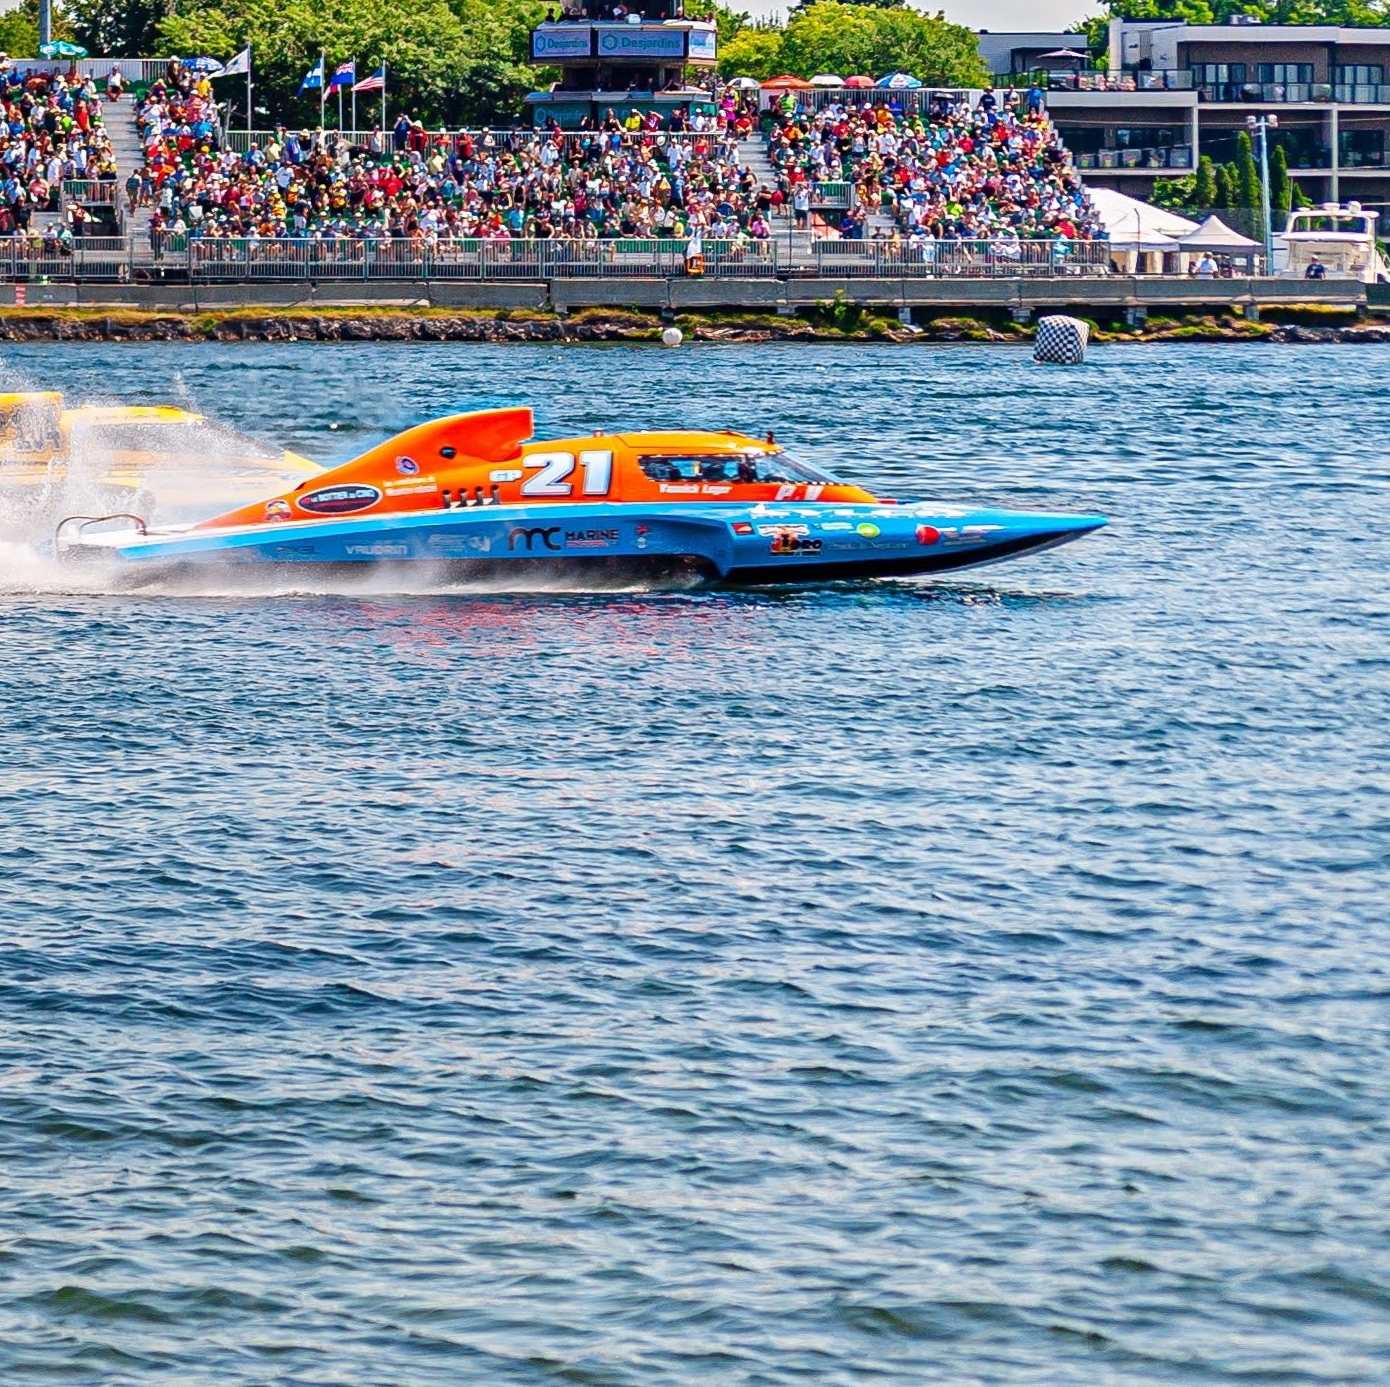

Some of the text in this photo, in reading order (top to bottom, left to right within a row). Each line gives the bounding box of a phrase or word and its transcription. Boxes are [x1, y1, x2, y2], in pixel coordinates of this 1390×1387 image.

[547, 37, 588, 50] Desjardins
[621, 36, 680, 49] Desjardins
[520, 450, 614, 496] 21
[565, 529, 619, 540] MARINE
